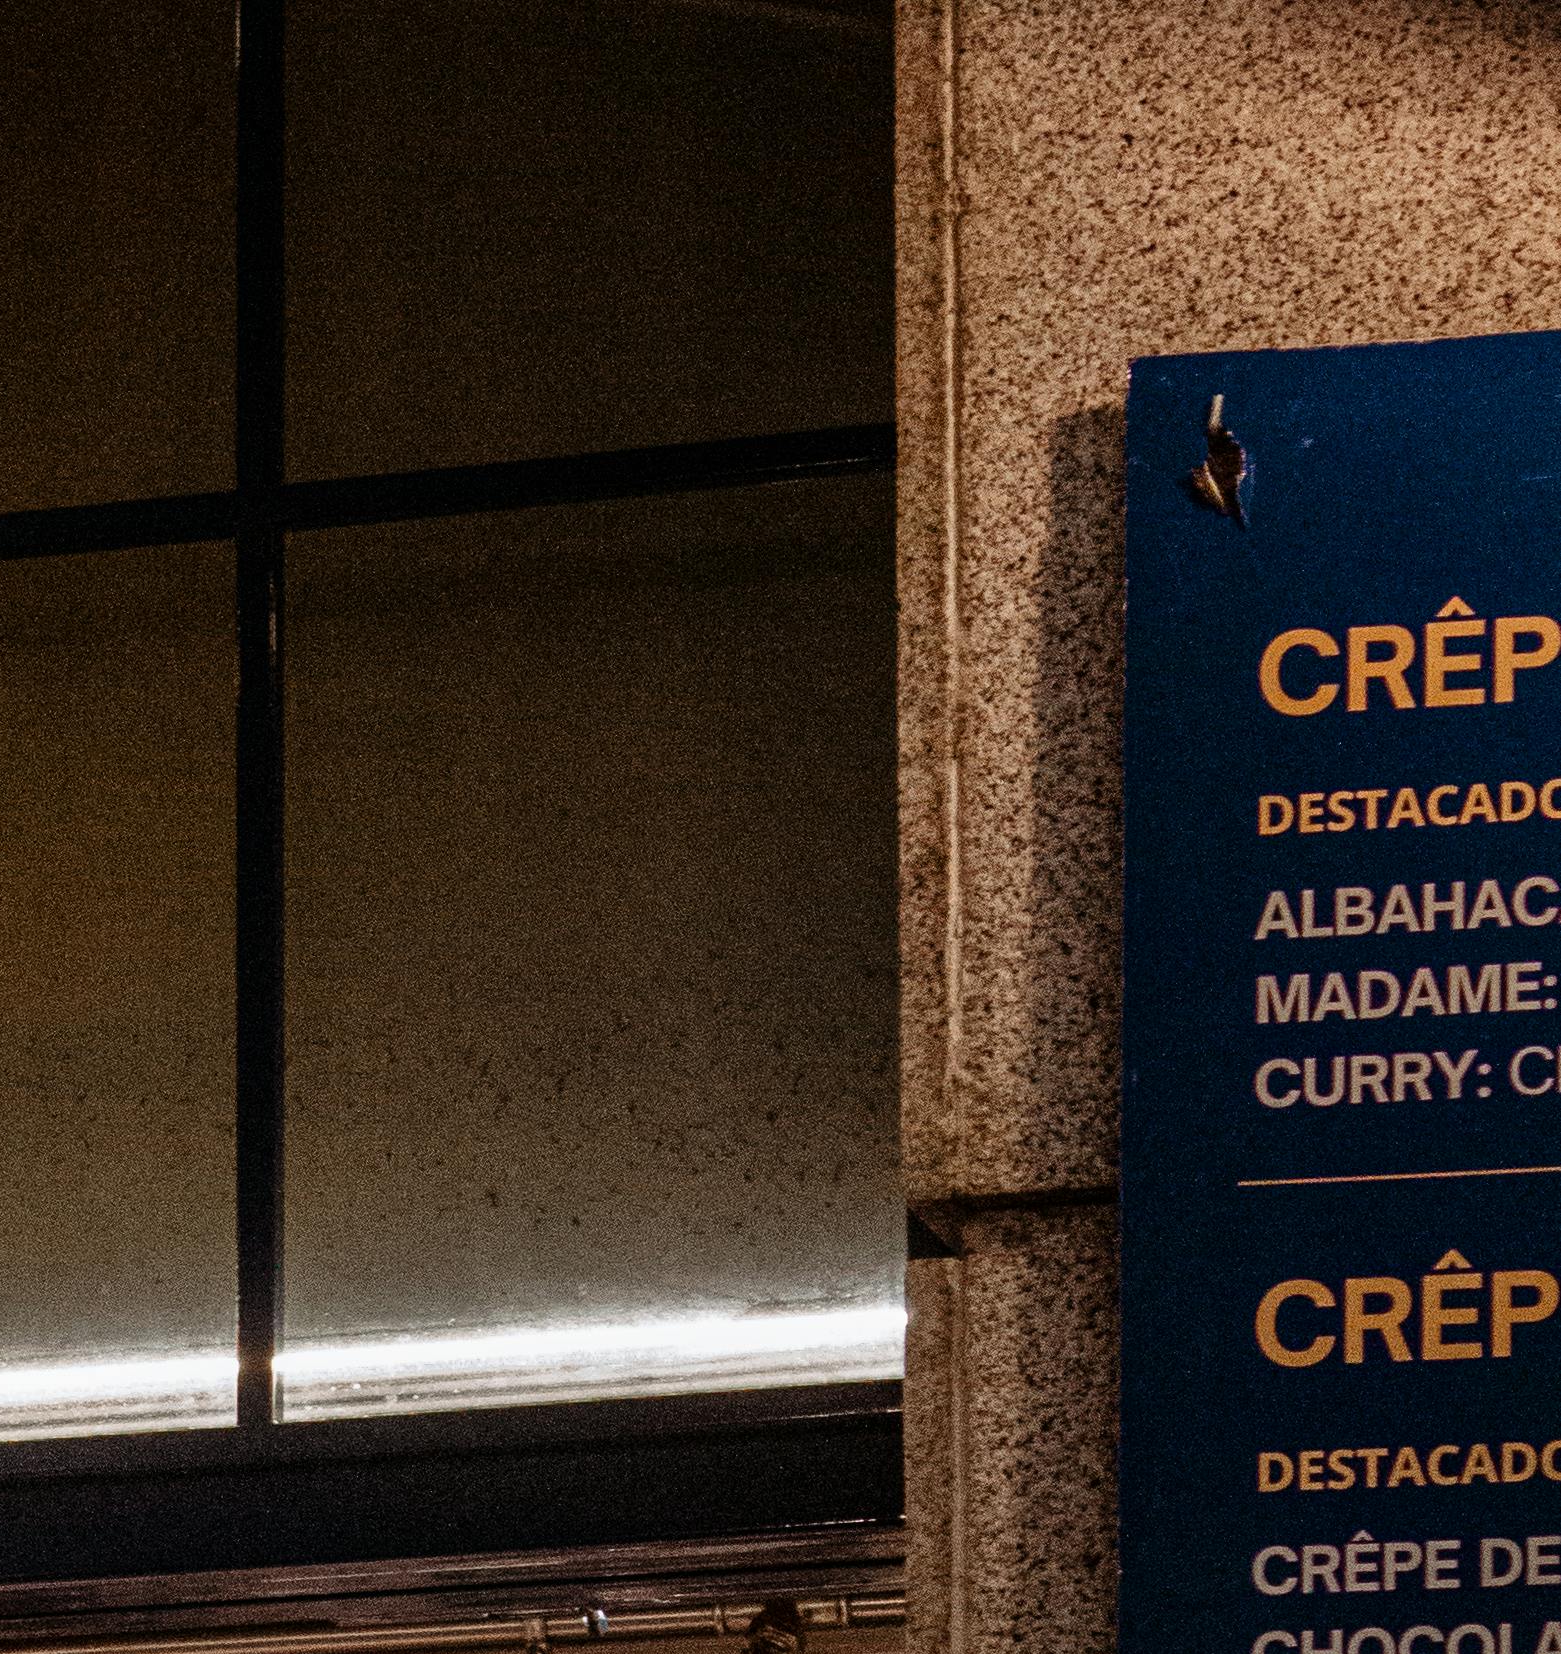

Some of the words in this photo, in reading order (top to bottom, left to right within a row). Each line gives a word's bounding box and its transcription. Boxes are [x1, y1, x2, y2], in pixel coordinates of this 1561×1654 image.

[1259, 595, 1561, 717] CRÊP
[1254, 875, 1560, 941] ALBAHAC
[1256, 960, 1558, 1024] MADAME:
[1254, 1049, 1492, 1108] CURRY:
[1509, 1045, 1561, 1096] C
[1254, 1248, 1560, 1368] CRÊP
[1252, 1529, 1461, 1596] CRÊPE
[1480, 1534, 1561, 1588] DE
